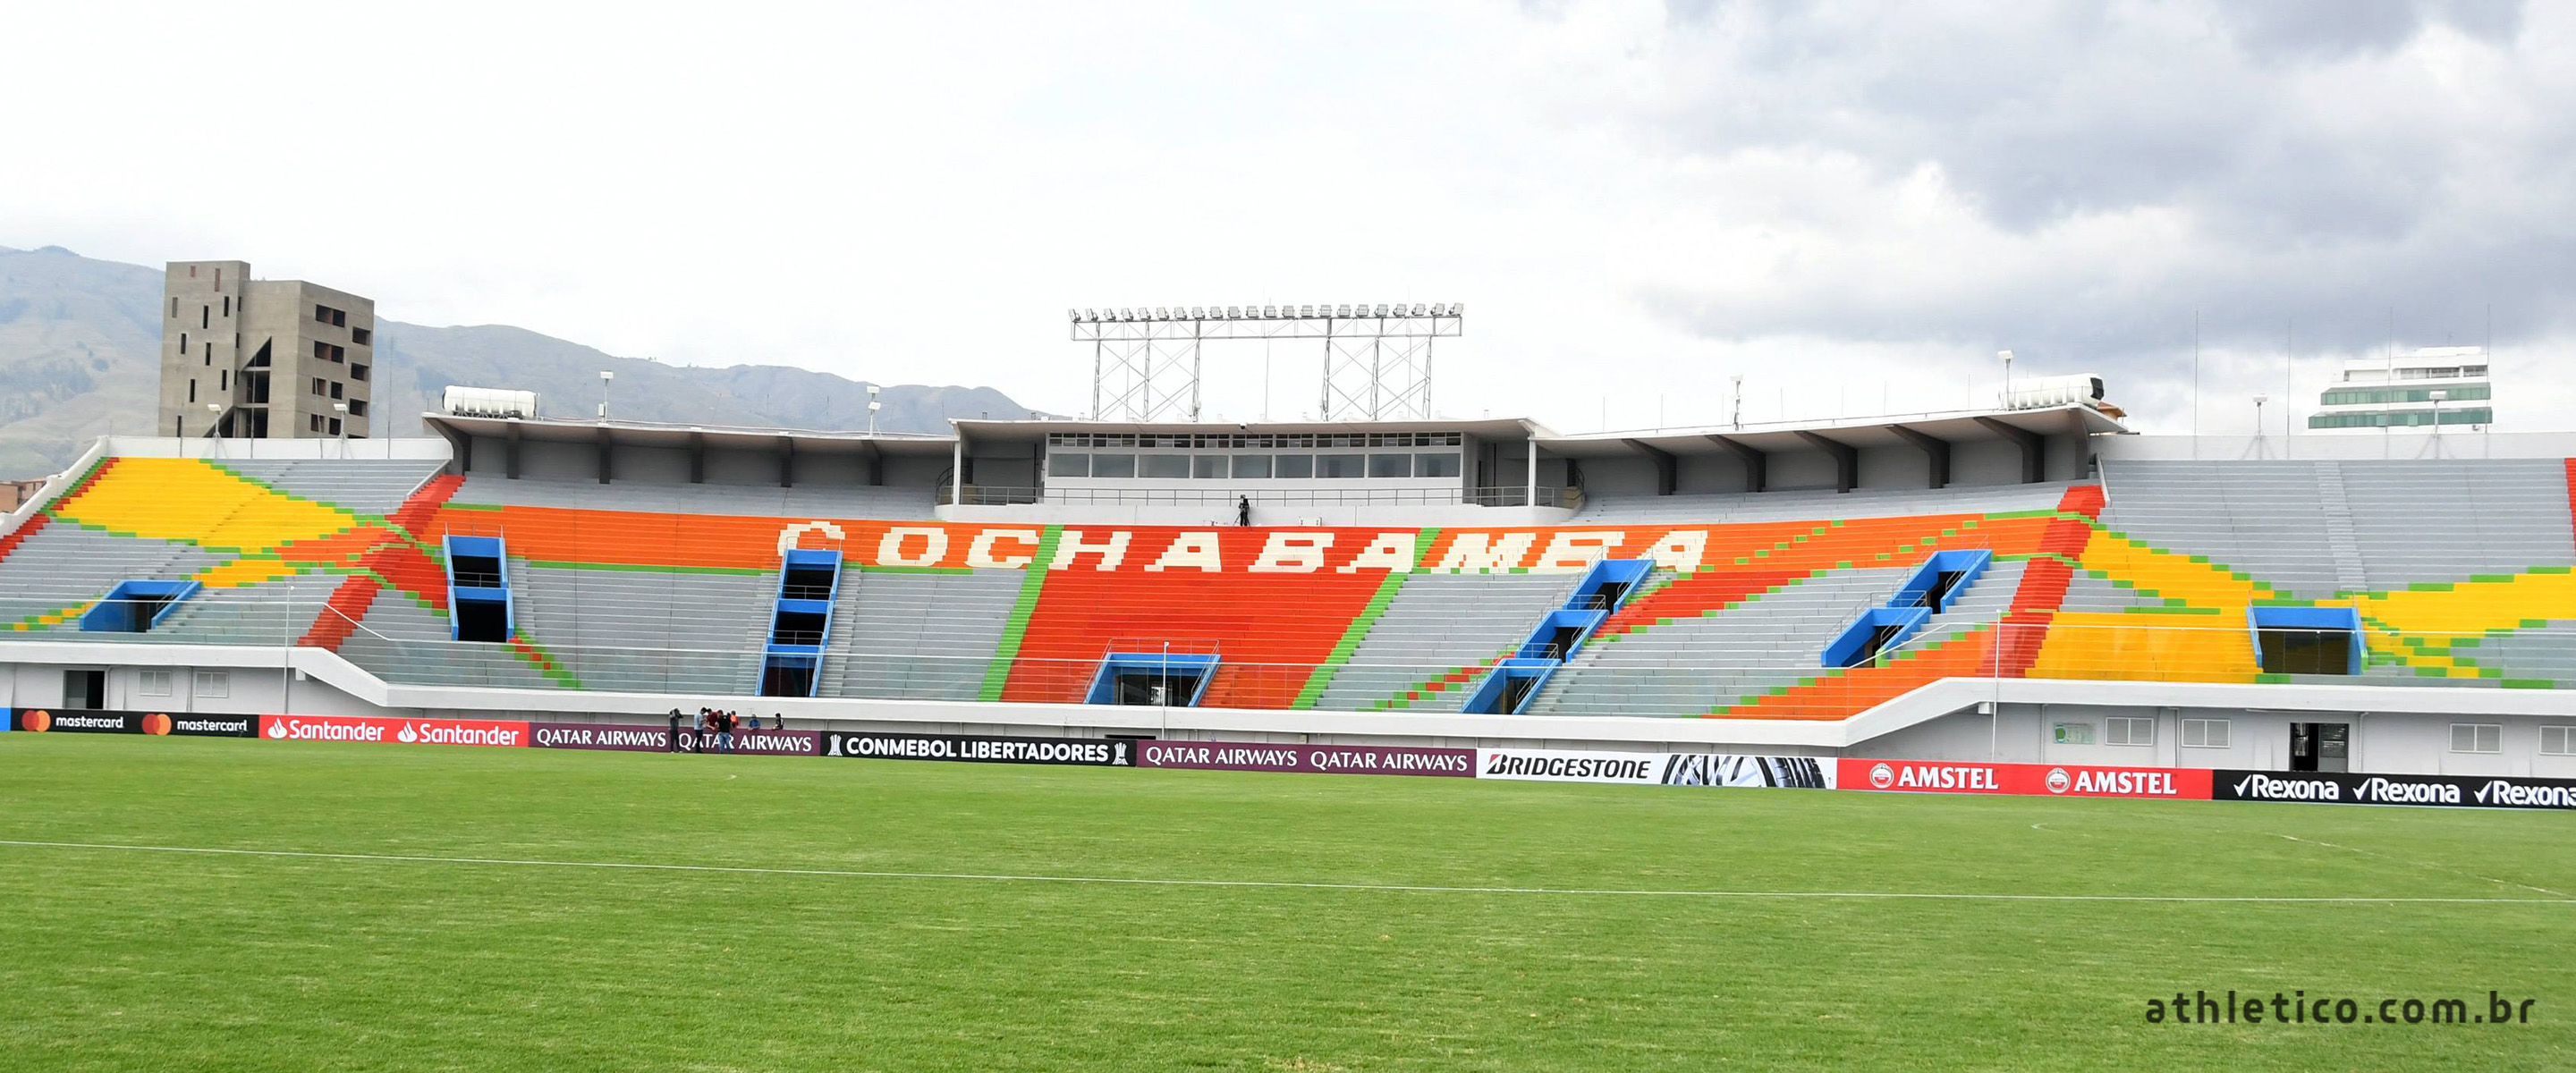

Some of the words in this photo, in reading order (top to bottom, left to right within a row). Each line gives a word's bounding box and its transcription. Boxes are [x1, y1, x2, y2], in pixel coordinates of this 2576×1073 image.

[56, 716, 123, 728] mastercard
[178, 720, 246, 731] mastercard
[290, 720, 385, 740] Santander
[420, 723, 519, 745] Santander
[538, 729, 591, 746] QATAR
[597, 731, 665, 747] AIRWAYS
[739, 736, 811, 751] AIRWAYS
[847, 737, 958, 756] CONMEBOL
[962, 741, 1107, 761] LIBERTADORES
[1147, 747, 1209, 765] QATAR
[1216, 749, 1297, 765] AIRWAYS
[1311, 752, 1377, 770] QATAR
[1383, 754, 1467, 771] AIRWAYS
[1487, 755, 1650, 778] BRIDGESTONE
[1898, 766, 1998, 789] AMSTEL
[2074, 771, 2176, 793] AMSTEL
[2252, 774, 2338, 799] Rexona
[2372, 778, 2460, 802] Rexona
